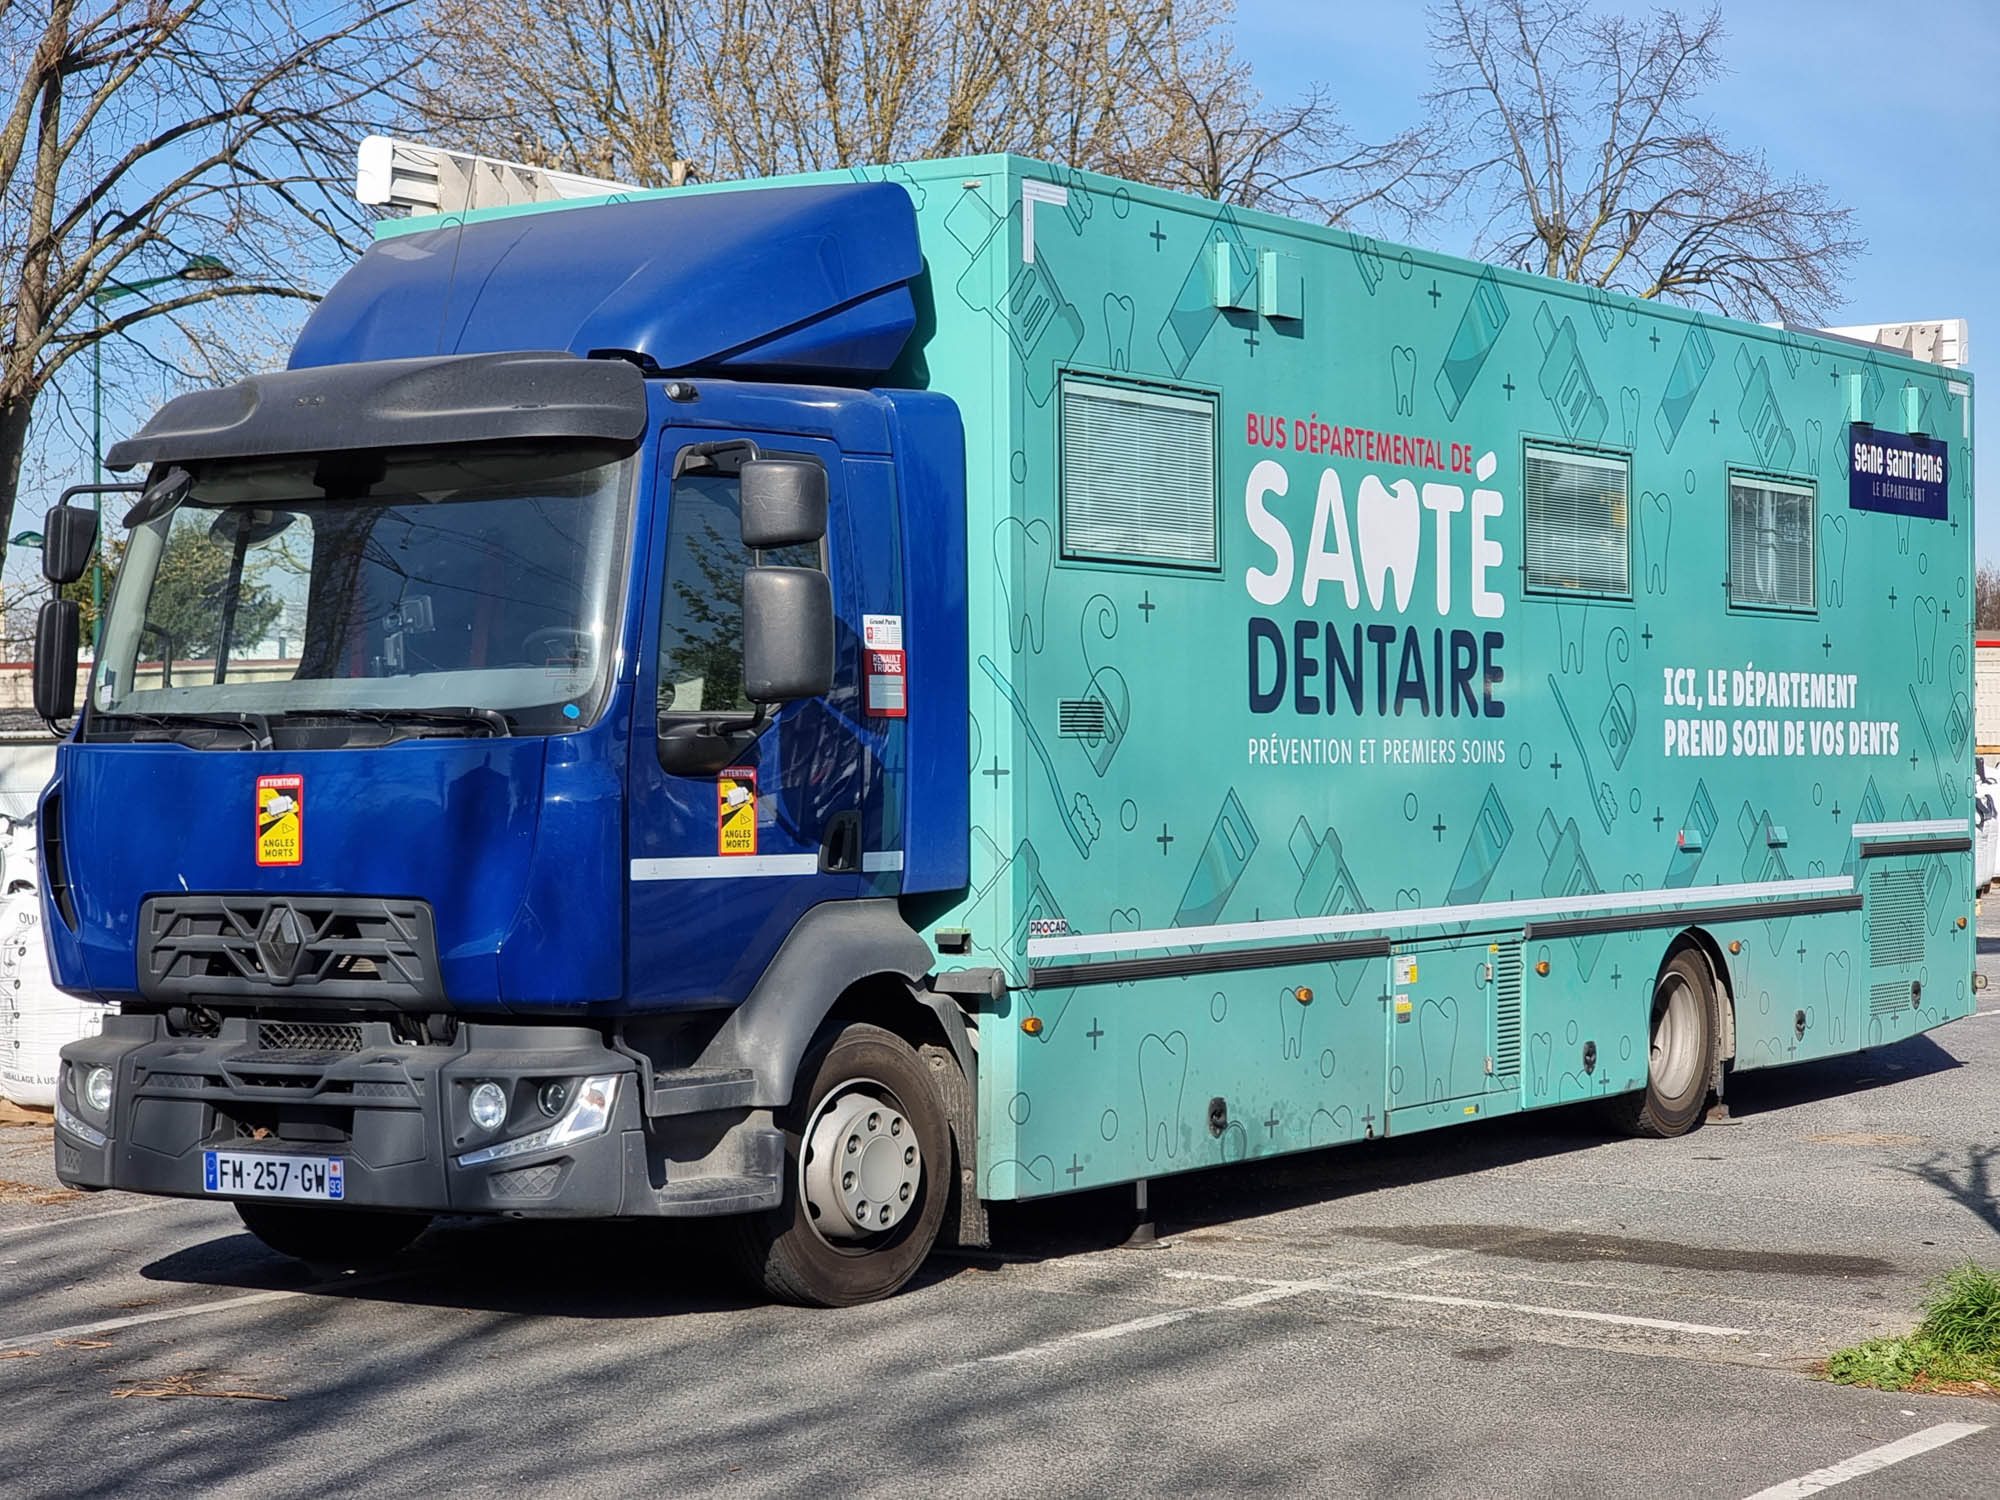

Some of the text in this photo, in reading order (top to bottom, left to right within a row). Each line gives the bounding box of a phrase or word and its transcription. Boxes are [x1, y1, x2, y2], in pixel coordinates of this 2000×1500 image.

[1247, 413, 1472, 474] BUS DÉPARTEMENTAL DE
[1872, 481, 1926, 502] LE DÉPARTEMENT
[872, 653, 901, 664] RENAULT
[872, 664, 902, 673] TRUCKS
[1249, 617, 1505, 718] DENTAIRE
[1663, 661, 1858, 711] ICI, LE DÉPARTEMENT
[1664, 719, 1899, 756] PREND SOIN DE VOS DENTS
[1248, 732, 1506, 764] PRÉVENTION ET PREMIERS SOINS
[720, 769, 754, 777] ATTENTION
[260, 778, 300, 787] ATTENTION
[725, 829, 751, 839] ANGLES
[264, 839, 295, 848] ANGLES
[726, 839, 750, 849] MORTS
[265, 849, 293, 857] MORTS
[1030, 921, 1068, 934] PROCAR
[220, 1160, 326, 1193] FM-257-GW
[329, 1181, 342, 1193] 93
